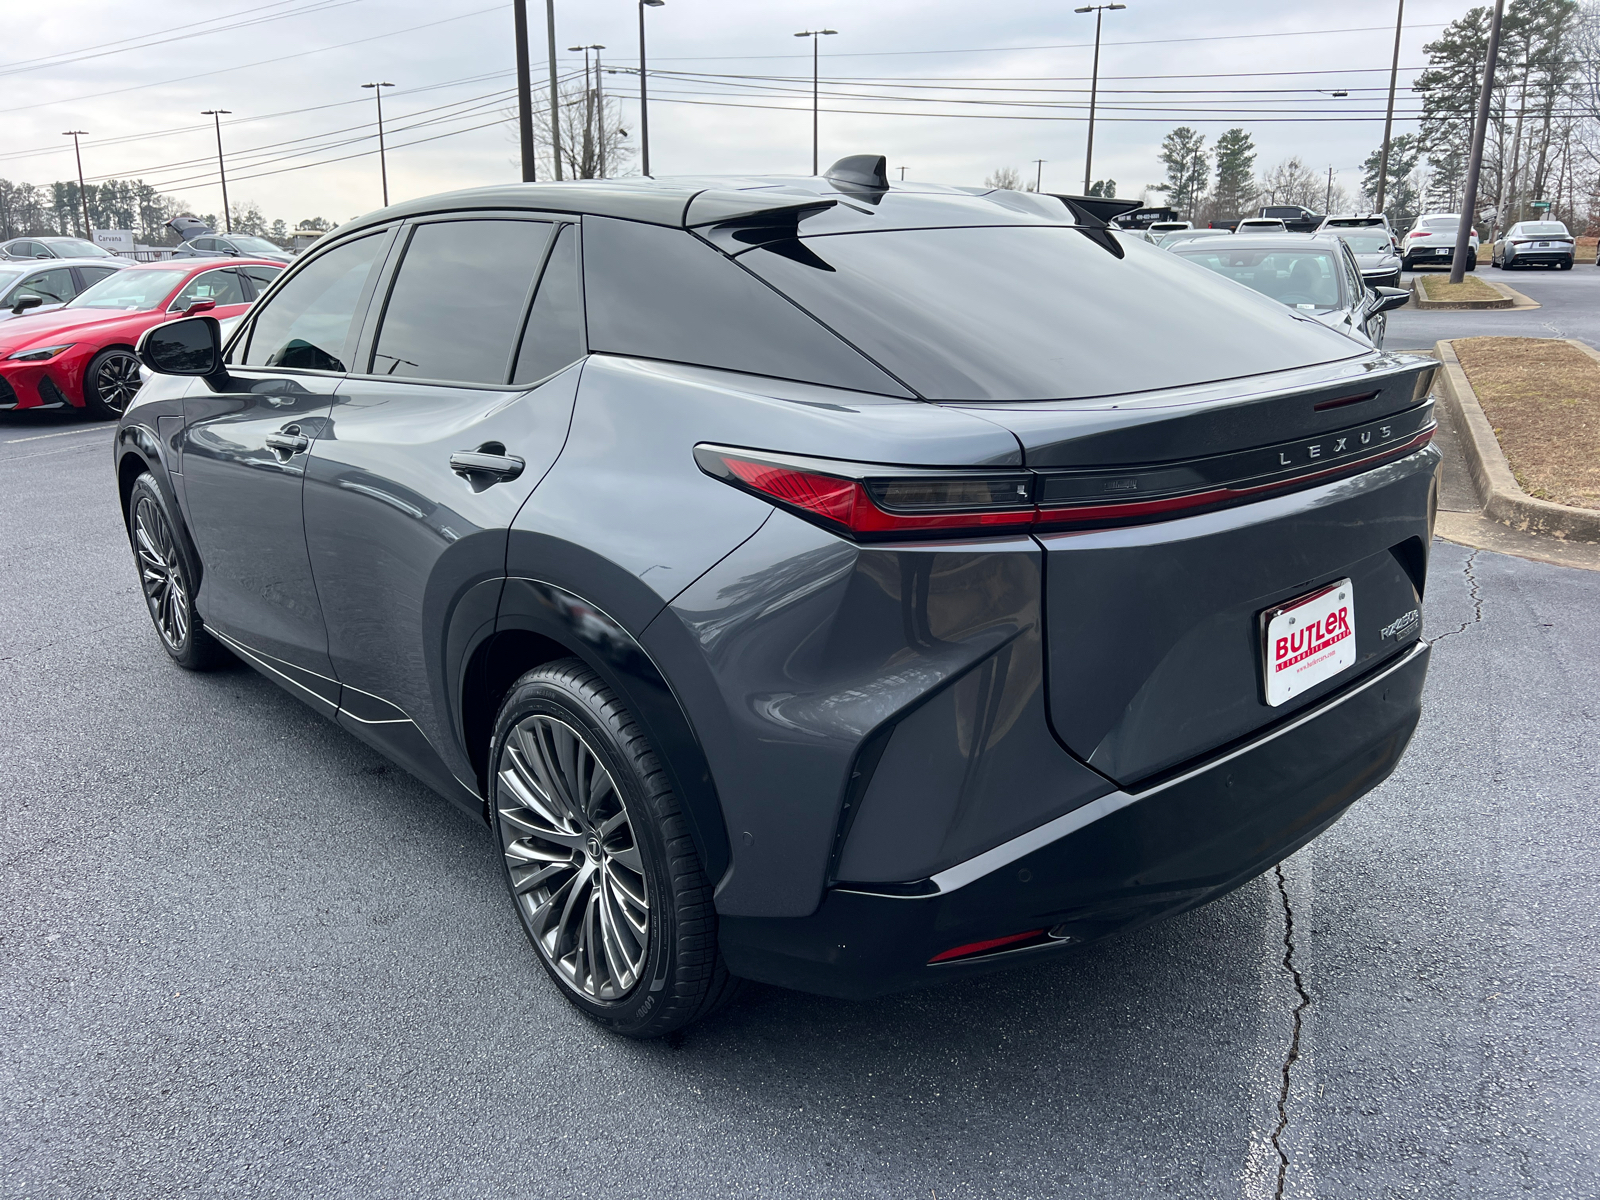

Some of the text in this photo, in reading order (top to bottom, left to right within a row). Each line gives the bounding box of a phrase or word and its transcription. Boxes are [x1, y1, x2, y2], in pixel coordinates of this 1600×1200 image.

[98, 234, 122, 242] Carvana
[1279, 425, 1392, 466] LEXUS
[1276, 629, 1350, 672] AUTOMOTIVE GROUP
[1296, 650, 1336, 674] www.butlercars.com
